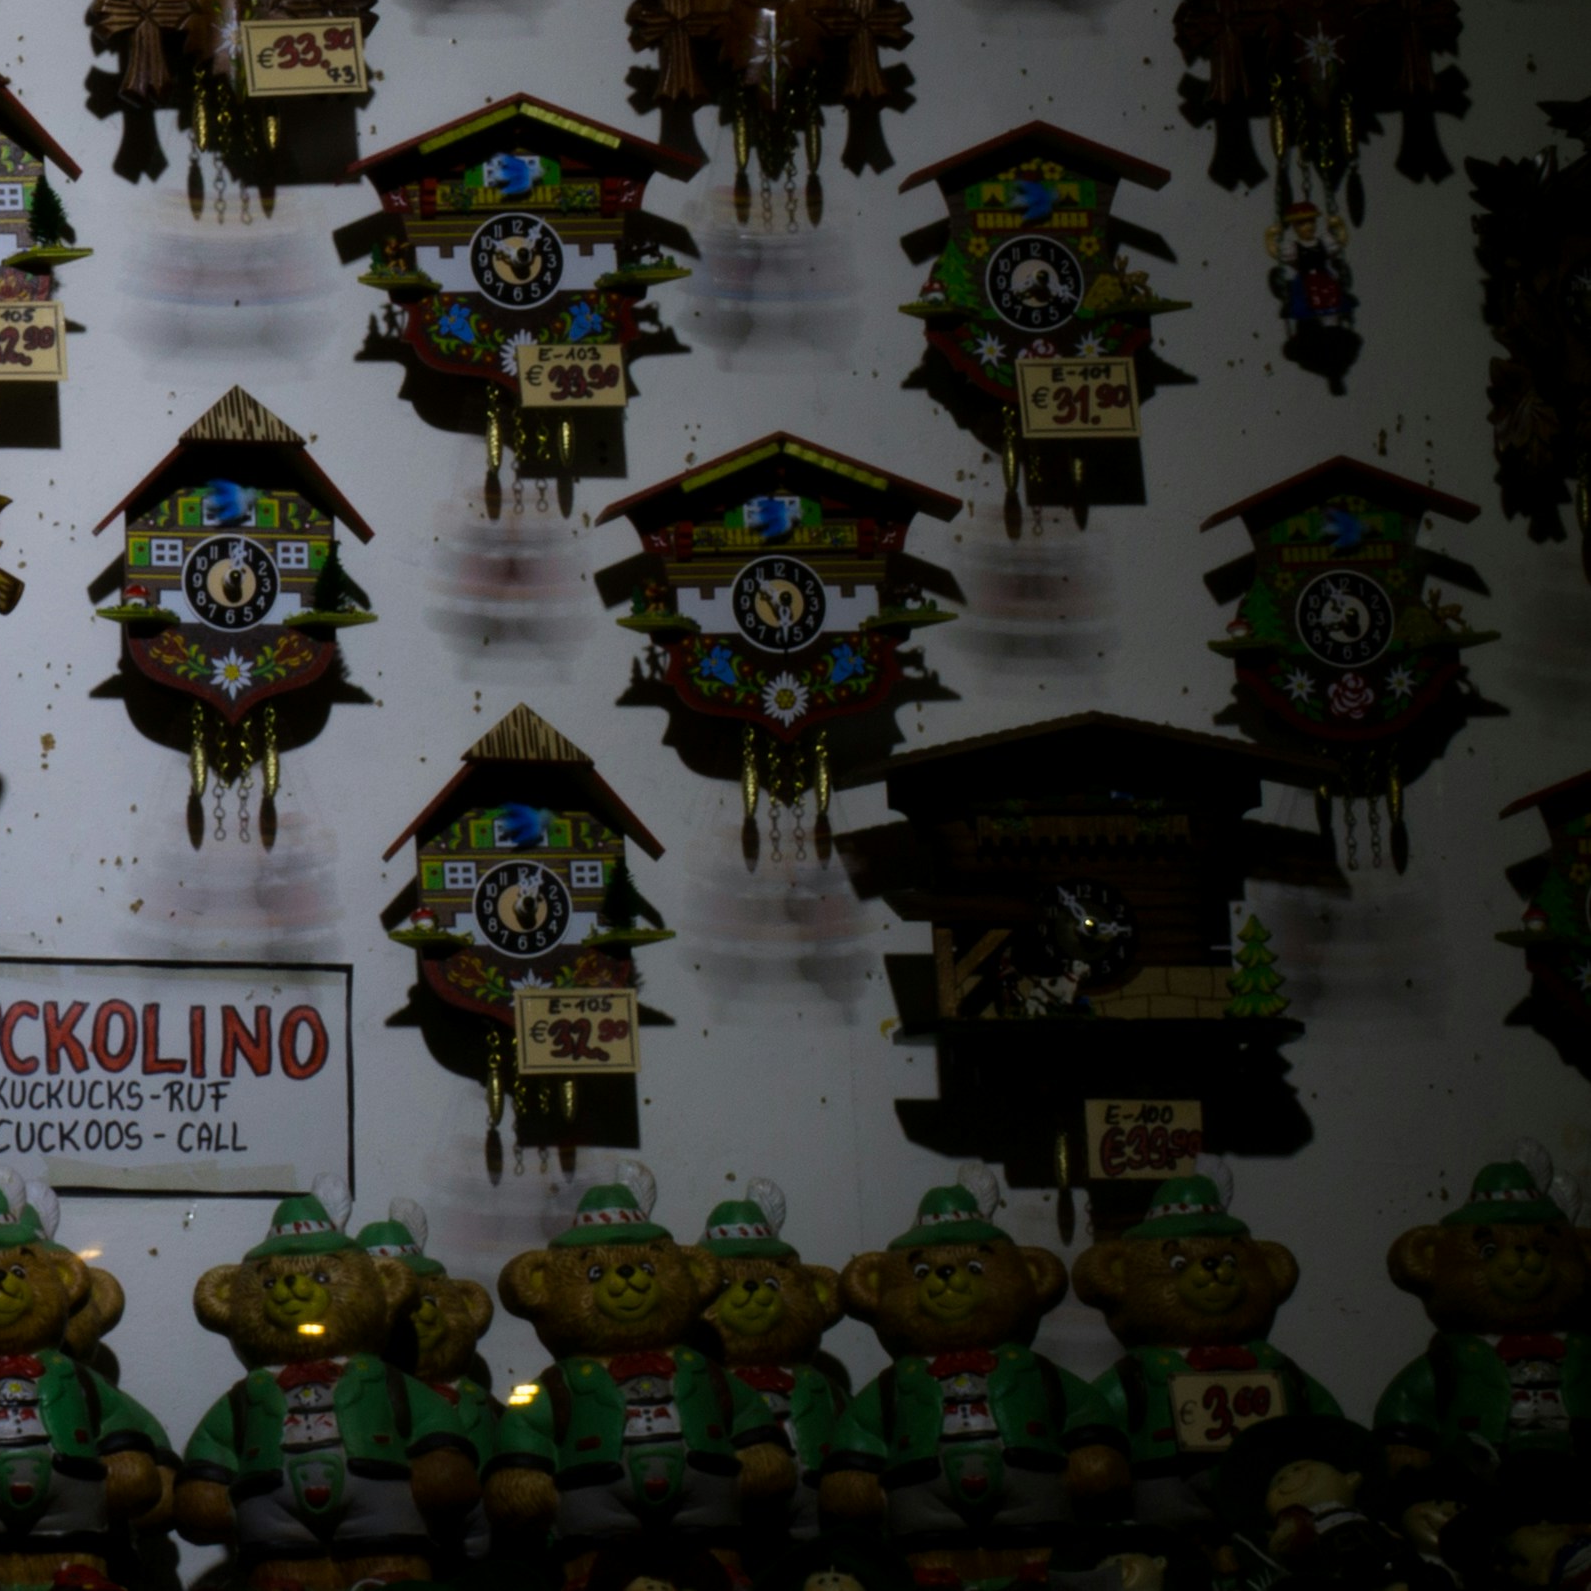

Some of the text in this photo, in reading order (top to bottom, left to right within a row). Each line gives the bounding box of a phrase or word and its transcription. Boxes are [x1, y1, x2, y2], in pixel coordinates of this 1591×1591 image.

[257, 48, 275, 68] €
[525, 364, 544, 386] €
[1032, 387, 1051, 408] €
[530, 1020, 549, 1043] €
[177, 1123, 247, 1152] CALL
